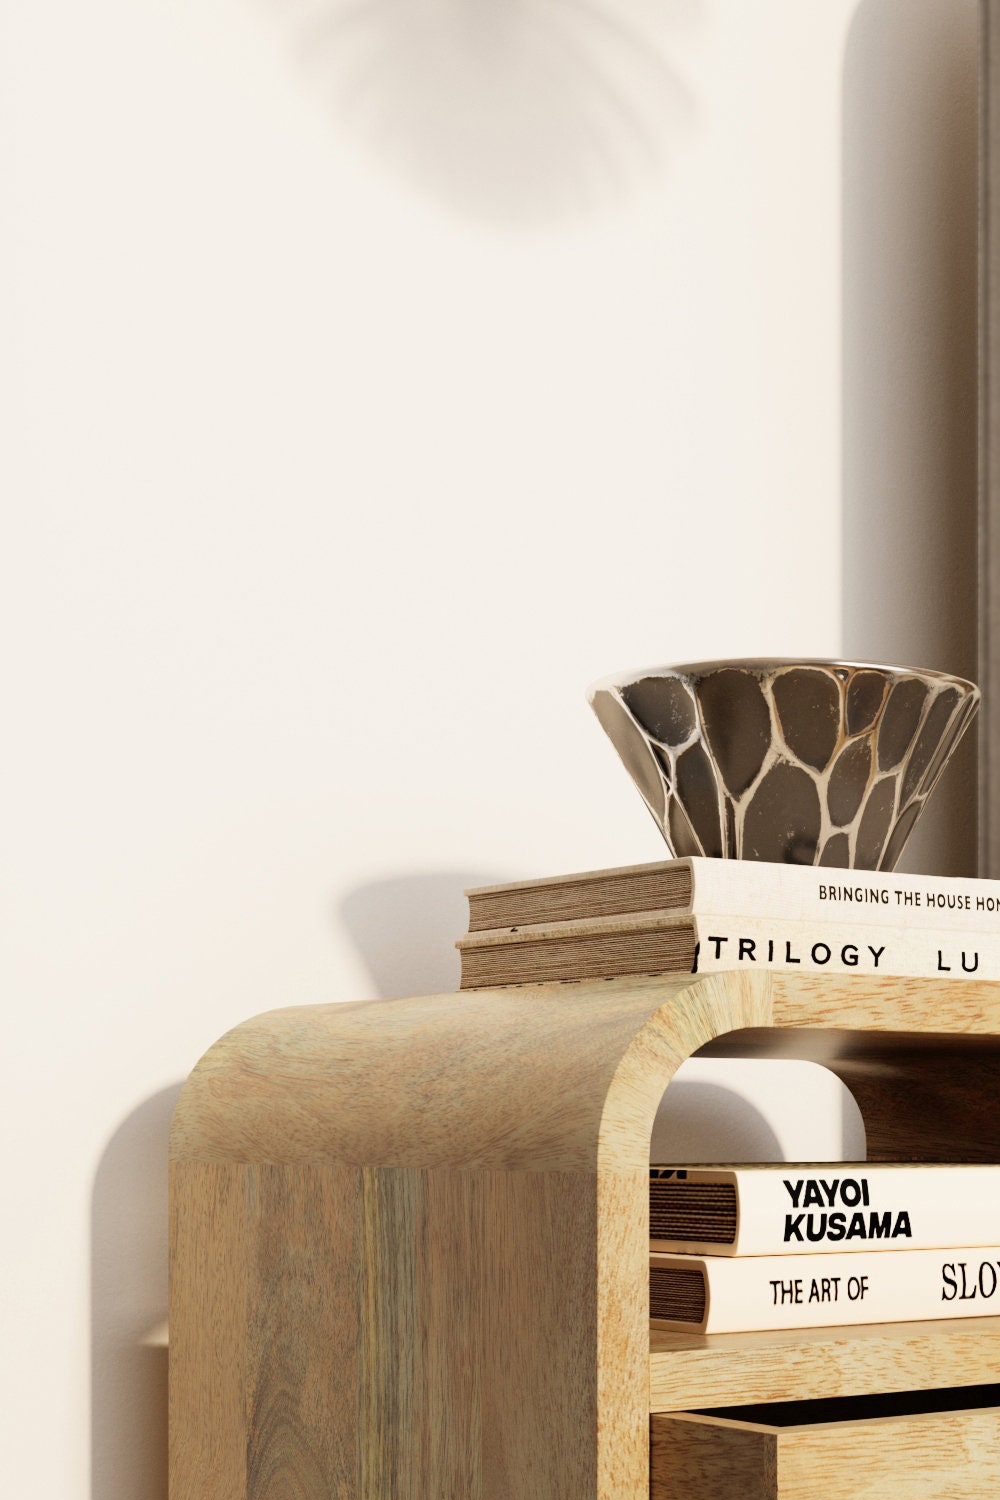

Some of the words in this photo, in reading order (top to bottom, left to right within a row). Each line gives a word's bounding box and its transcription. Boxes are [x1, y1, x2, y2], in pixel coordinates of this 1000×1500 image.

[819, 885, 889, 905] BRINGING
[894, 890, 921, 907] THE
[926, 893, 971, 910] HOUSE
[707, 935, 886, 968] TRILOGY
[937, 950, 979, 973] LU
[782, 1178, 870, 1209] YAYOI
[783, 1210, 913, 1242] KUSAMA
[769, 1279, 804, 1305] THE
[808, 1277, 841, 1304] ART
[847, 1275, 869, 1301] OF
